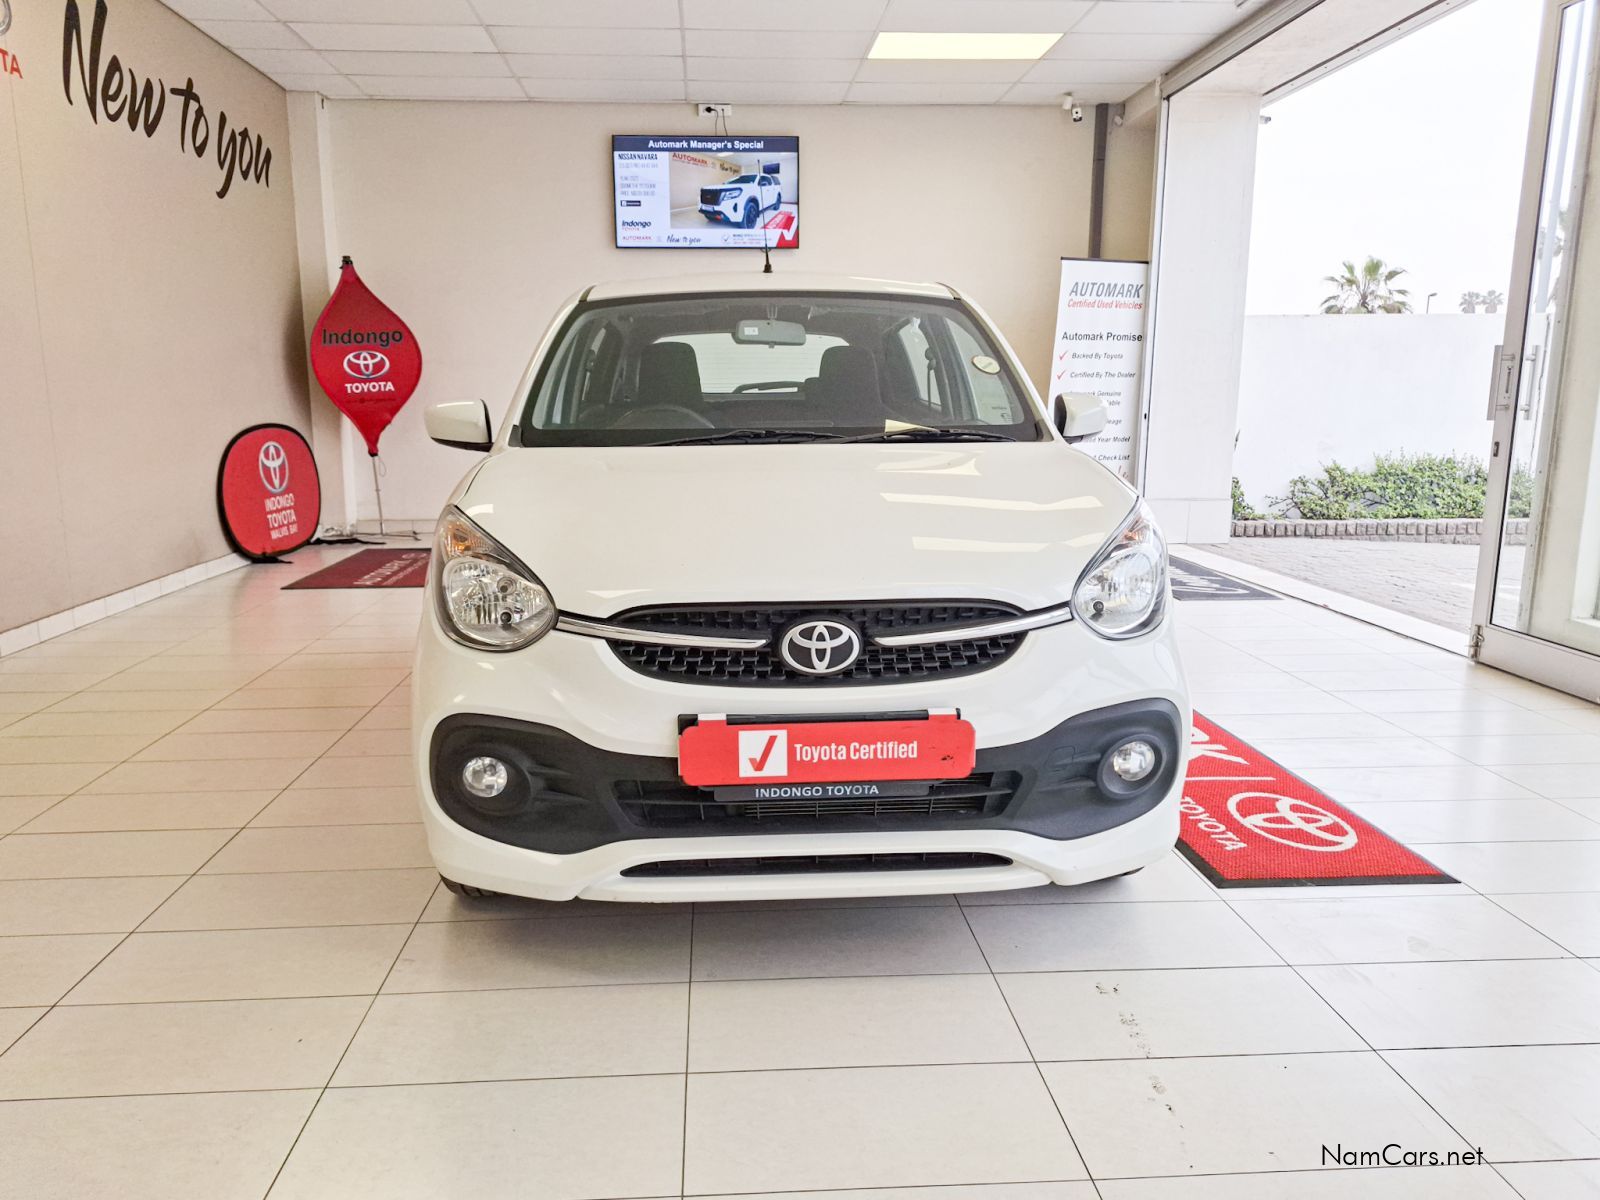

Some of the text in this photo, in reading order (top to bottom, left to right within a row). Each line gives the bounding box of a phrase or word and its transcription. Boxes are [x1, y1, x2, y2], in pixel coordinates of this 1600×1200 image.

[62, 0, 272, 200] New to you
[648, 140, 764, 151] Automark Manager's Special
[621, 219, 652, 228] Indongo
[1069, 281, 1144, 299] AUTOMARK
[1067, 298, 1143, 310] Certified Used Vehicles
[322, 328, 403, 348] Indongo
[1061, 331, 1143, 342] Automark Promise
[1071, 352, 1124, 361] Backed By Toyota
[1070, 371, 1095, 379] Certified
[1095, 372, 1103, 380] By
[1104, 371, 1116, 379] The
[344, 381, 395, 394] TOYOTA
[264, 493, 295, 512] INDONGO
[266, 509, 297, 529] TOYOTA
[794, 740, 918, 763] Toyota Certified
[755, 785, 879, 798] INDONGO TOYOTA
[1180, 796, 1248, 851] TOYOTA
